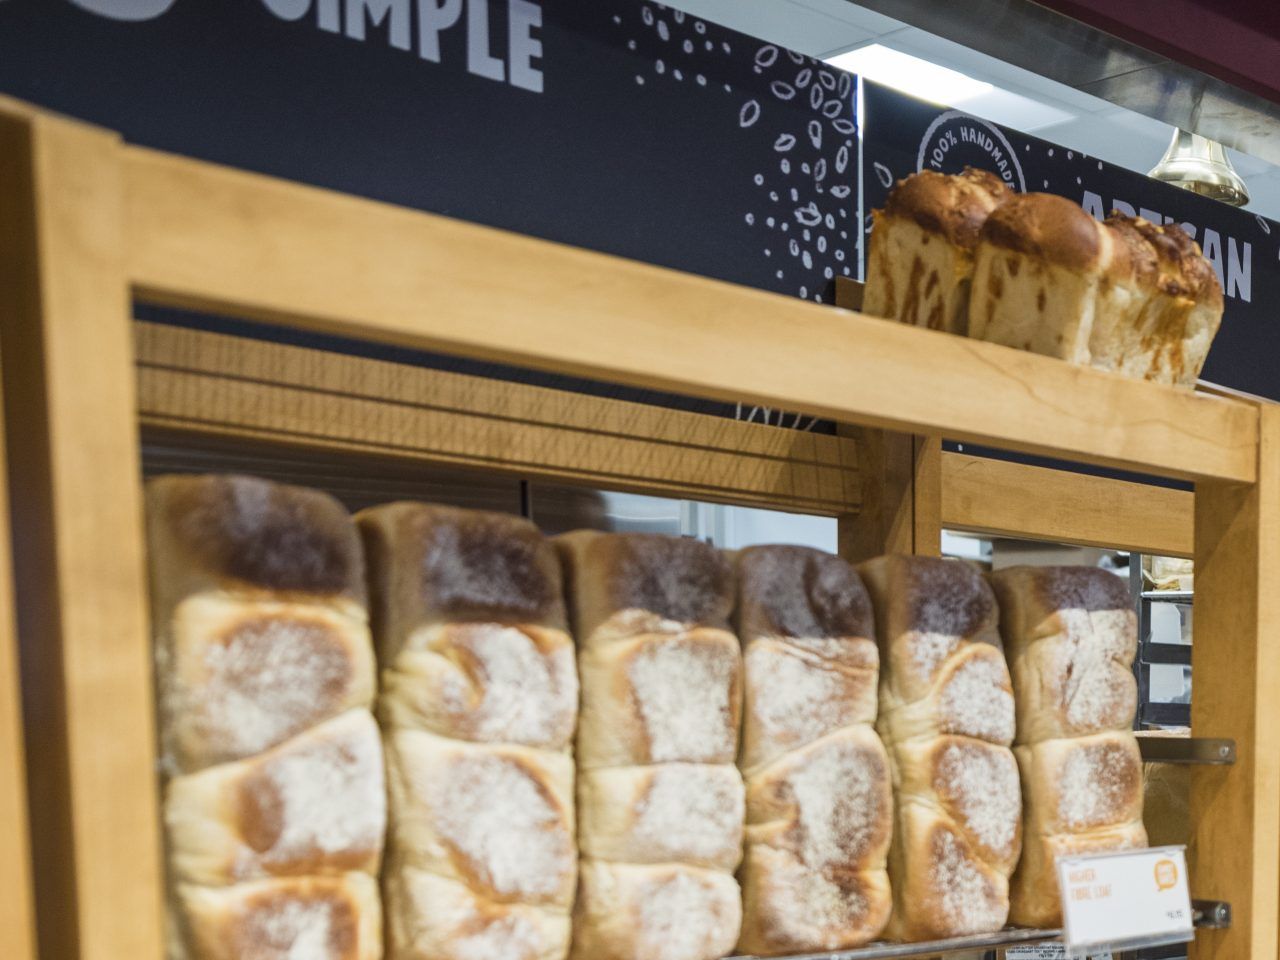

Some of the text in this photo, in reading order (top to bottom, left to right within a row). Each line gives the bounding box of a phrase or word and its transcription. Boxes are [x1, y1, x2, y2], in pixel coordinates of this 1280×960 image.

[262, 0, 544, 93] MPLE
[930, 125, 1015, 191] 100% HANDMADE
